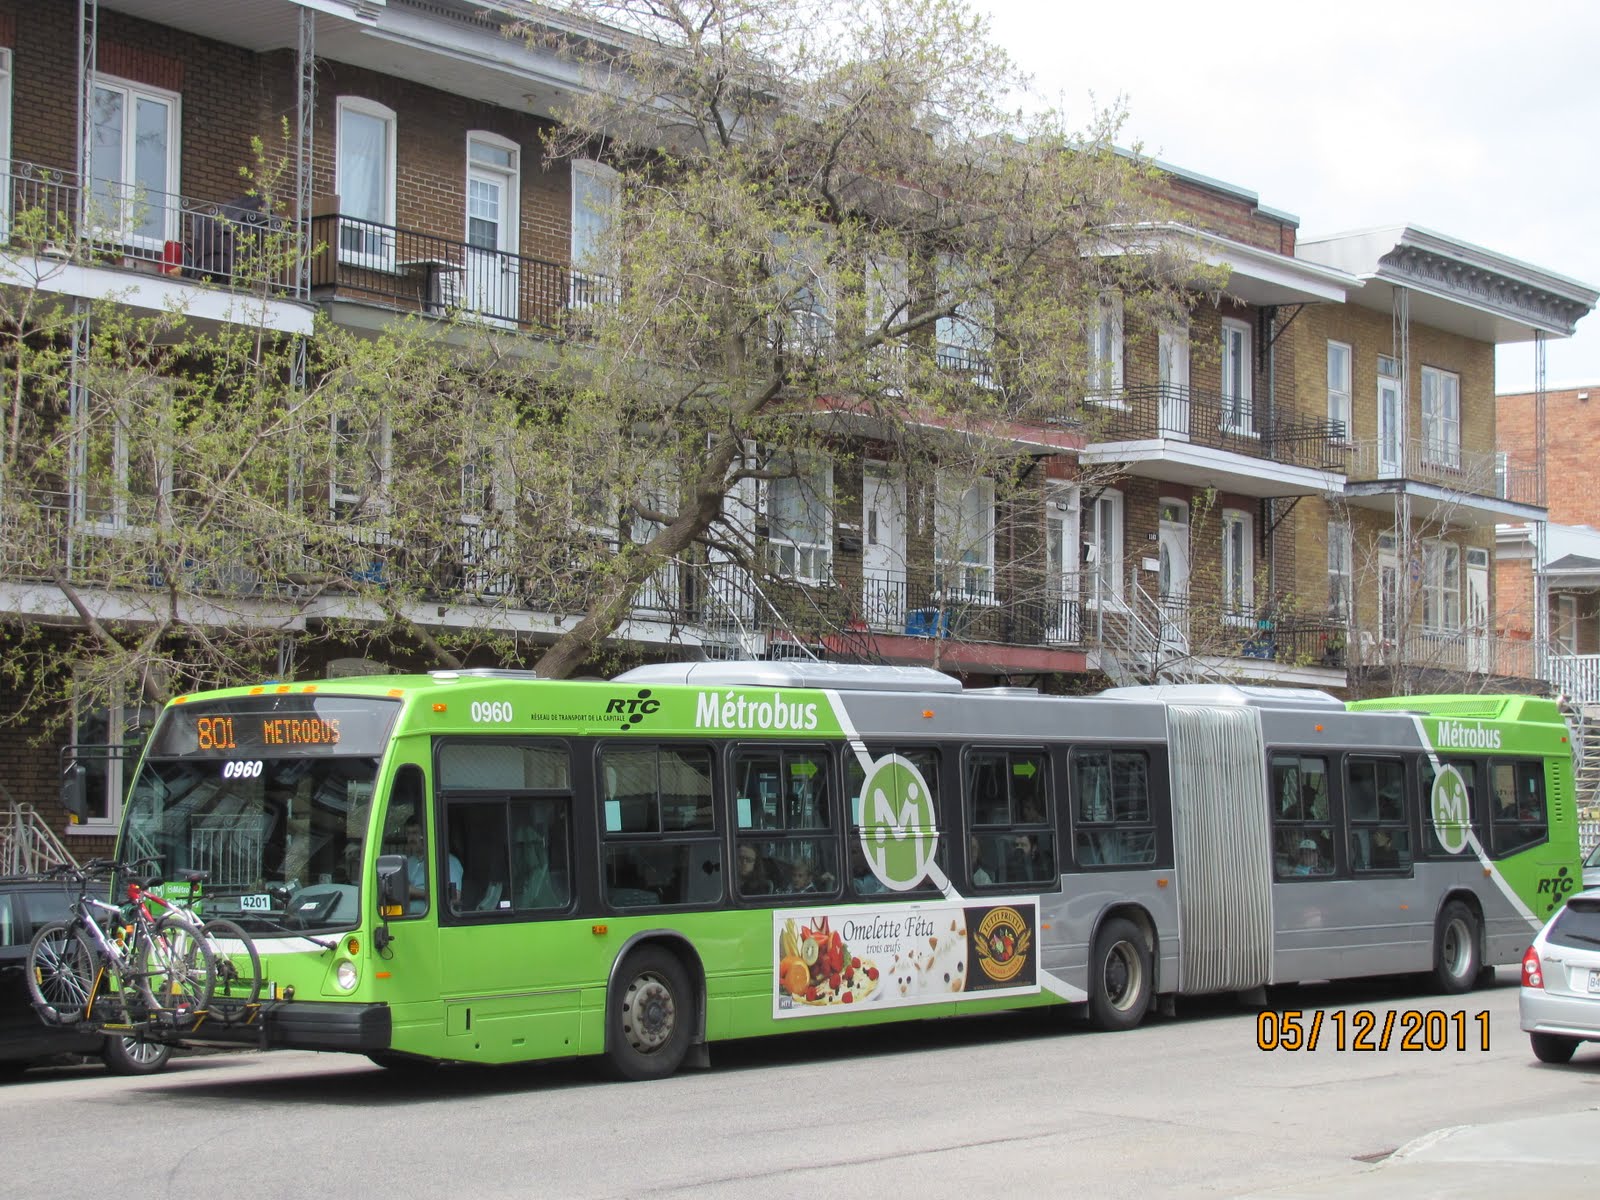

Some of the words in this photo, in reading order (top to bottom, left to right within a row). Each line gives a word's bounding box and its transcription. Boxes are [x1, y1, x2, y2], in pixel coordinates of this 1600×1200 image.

[471, 701, 513, 723] 0960
[605, 699, 661, 714] RTC
[695, 690, 818, 730] Métrobus
[530, 713, 550, 721] RÉSEAU
[588, 714, 595, 722] DE
[596, 714, 603, 722] LA
[603, 714, 626, 722] CAPITALE
[197, 717, 236, 749] 801
[264, 719, 341, 745] METROBUS
[1437, 720, 1501, 749] Métrobus
[224, 760, 263, 778] 0960
[1537, 877, 1574, 894] RTC
[243, 896, 268, 908] 4201
[842, 915, 901, 941] Omelette
[904, 915, 934, 938] Féta
[866, 942, 883, 955] trois
